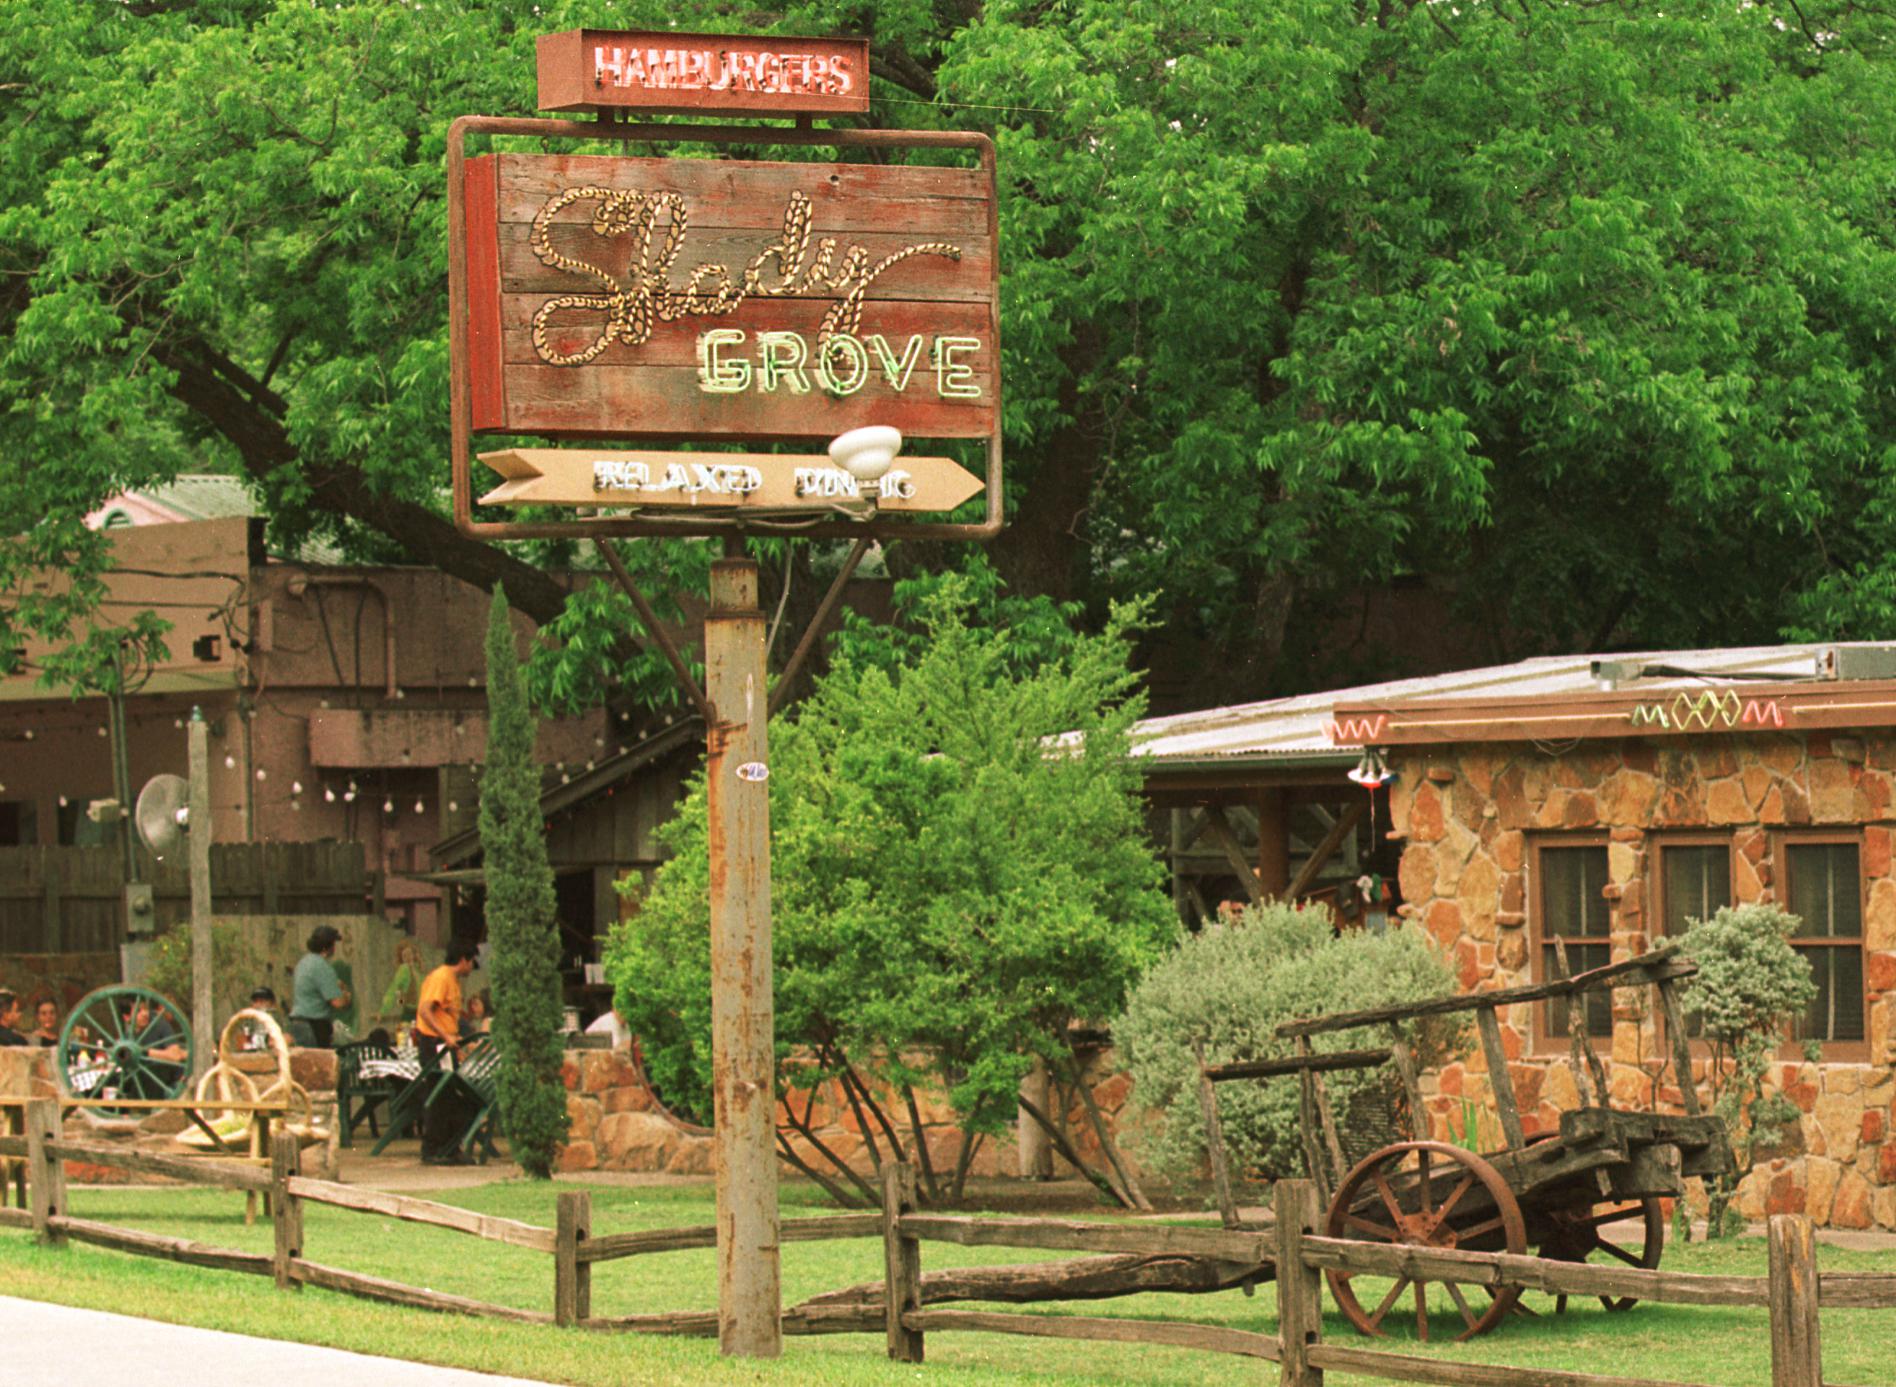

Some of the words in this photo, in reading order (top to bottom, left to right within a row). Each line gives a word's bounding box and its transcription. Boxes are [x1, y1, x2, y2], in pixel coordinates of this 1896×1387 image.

[594, 46, 853, 95] HAMBURGERS
[530, 185, 962, 367] Shady
[696, 328, 981, 397] GROVE
[593, 460, 763, 494] RELAXED
